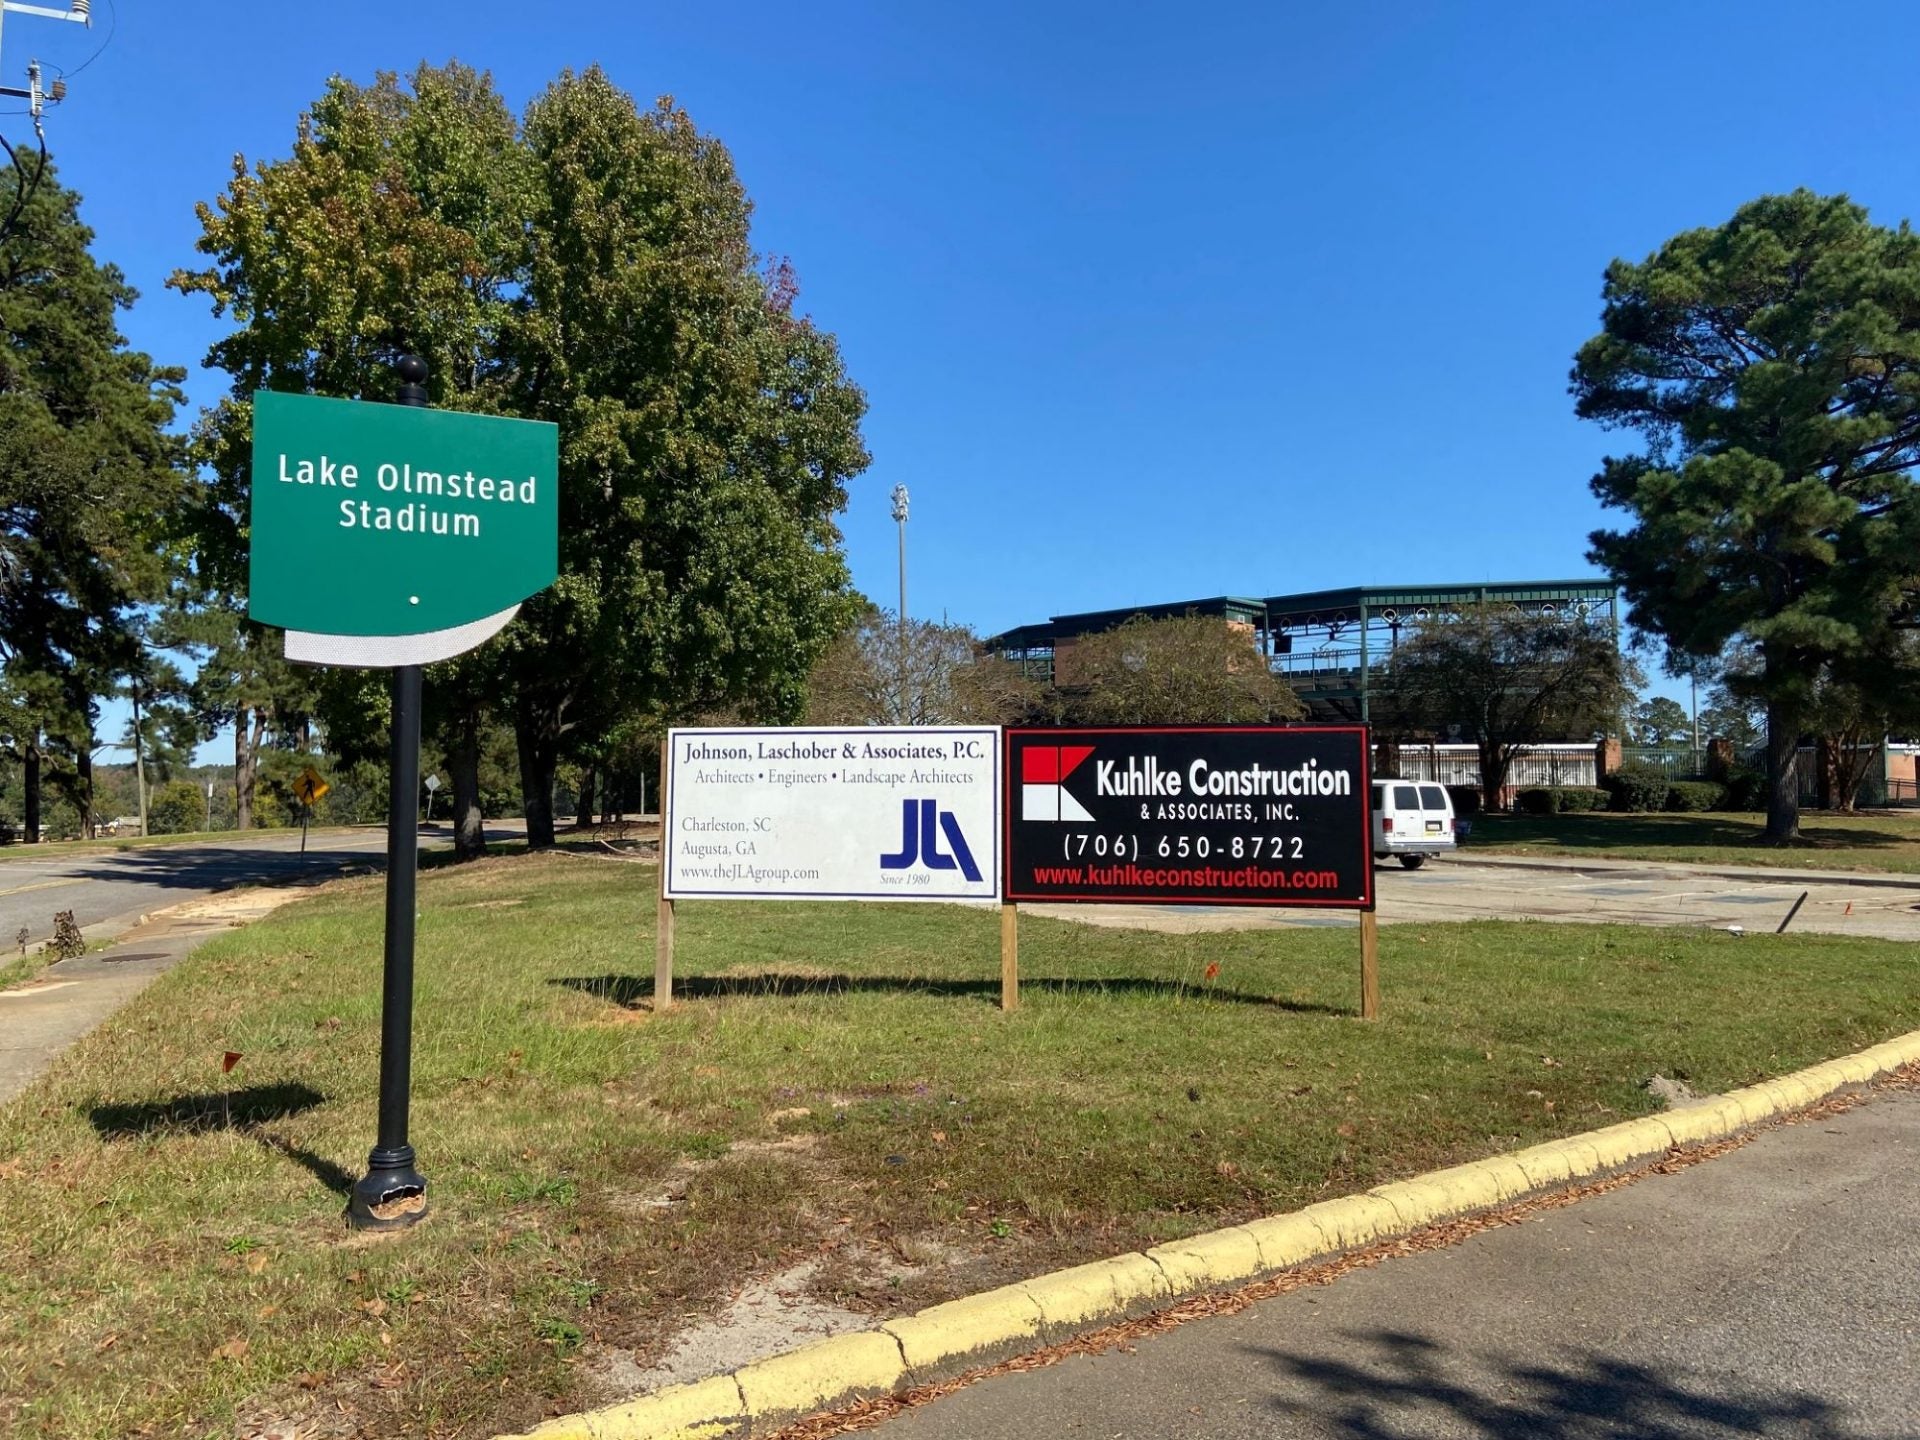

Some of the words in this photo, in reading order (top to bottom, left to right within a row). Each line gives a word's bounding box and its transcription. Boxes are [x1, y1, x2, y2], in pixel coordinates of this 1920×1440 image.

[279, 454, 359, 488] Lake
[377, 463, 537, 504] Olmstead
[339, 499, 480, 537] Stadium
[684, 742, 753, 764] Johnson,
[757, 742, 837, 761] Laschober
[841, 743, 857, 760] &
[861, 741, 948, 762] Associates,
[952, 740, 985, 759] P.C.
[695, 769, 755, 784] Architects
[768, 769, 828, 787] Engineers
[842, 768, 906, 786] Landscape
[910, 768, 974, 784] Architects
[1097, 756, 1182, 796] Kuhlke
[1188, 758, 1351, 796] Construction
[1140, 803, 1151, 820] &
[1157, 803, 1260, 823] ASSOCIATES,
[1265, 804, 1299, 821] INC.
[682, 817, 750, 834] Charleston,
[753, 818, 772, 832] SC
[681, 841, 732, 859] Augusta,
[735, 842, 757, 856] GA
[1064, 834, 1139, 861] (706)
[1158, 836, 1304, 859] 650-8722
[681, 863, 820, 882] www.theJLAgroup.com
[880, 873, 904, 884] Since
[907, 874, 930, 885] 1980
[1034, 865, 1338, 889] www.kuhlkeconstruction.com
